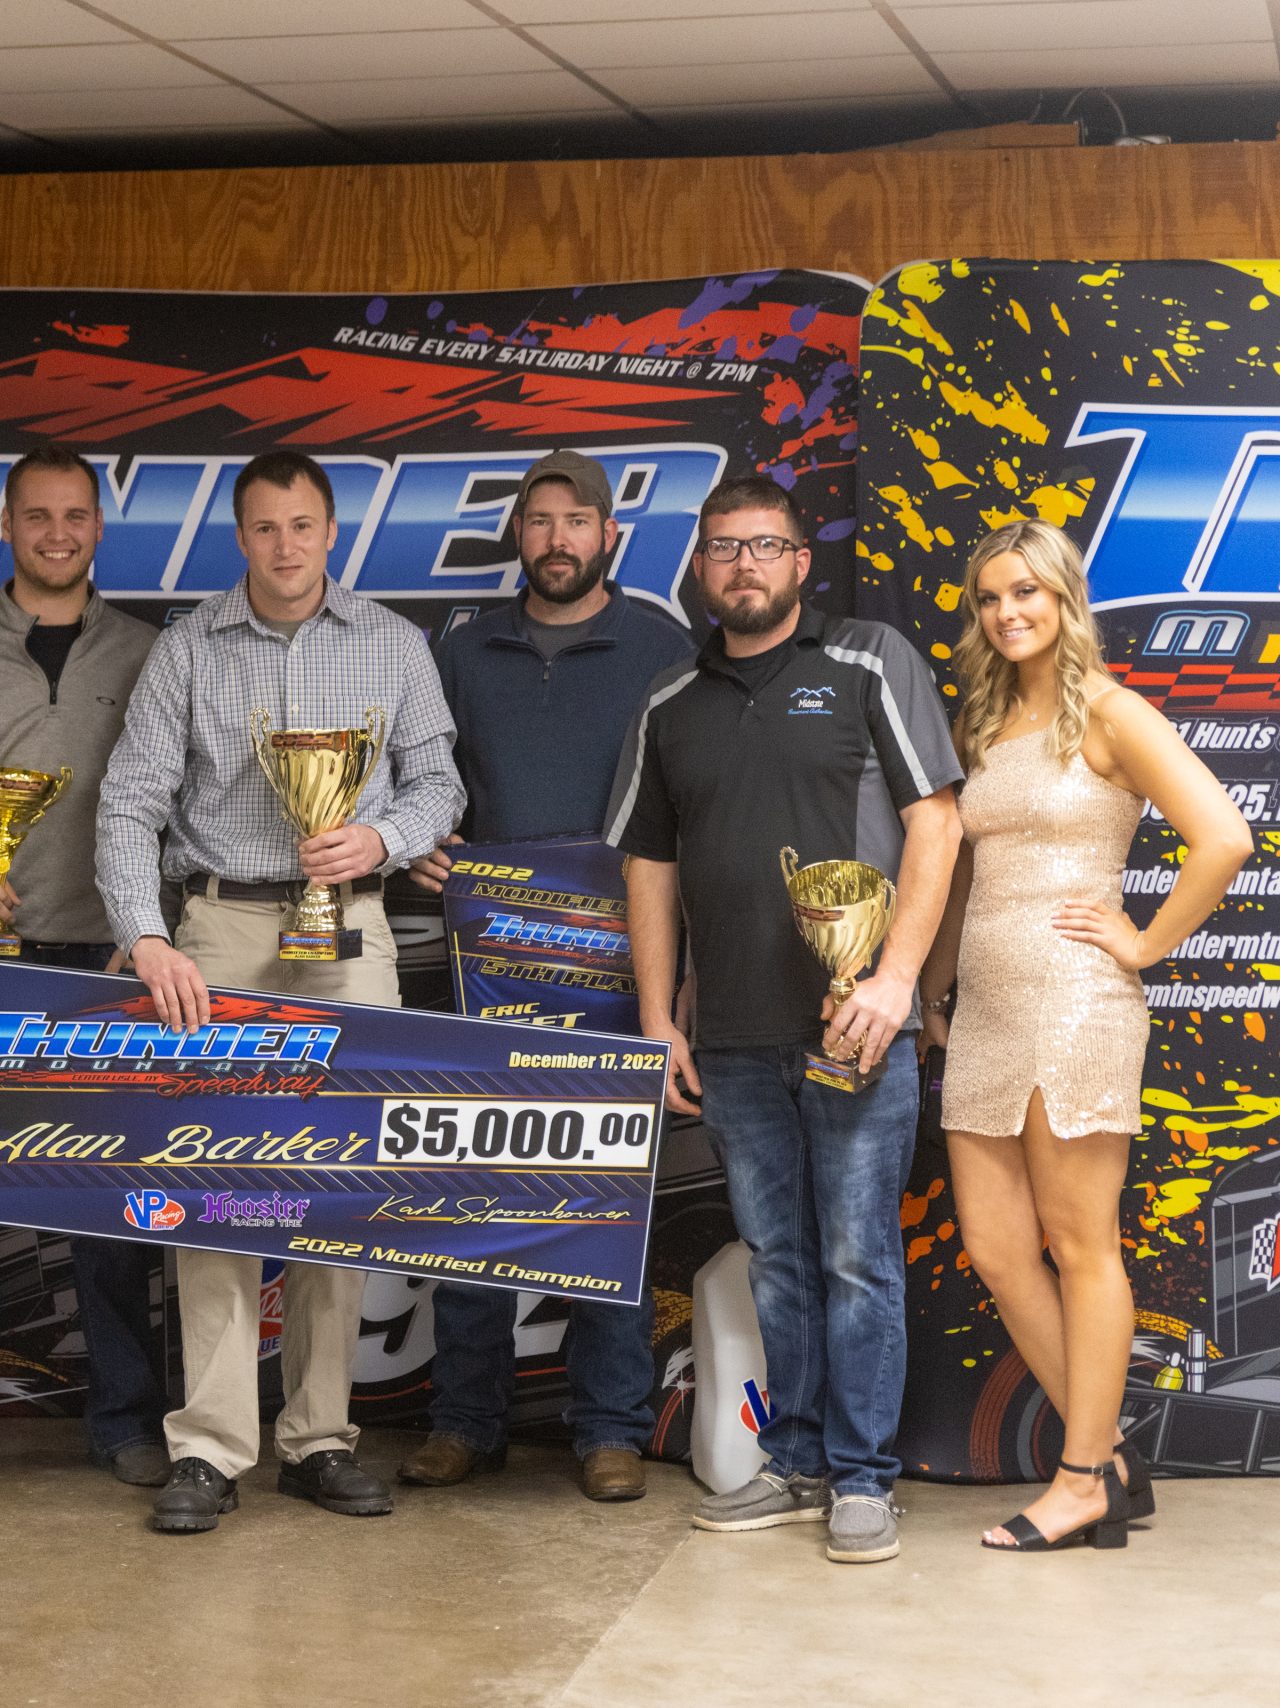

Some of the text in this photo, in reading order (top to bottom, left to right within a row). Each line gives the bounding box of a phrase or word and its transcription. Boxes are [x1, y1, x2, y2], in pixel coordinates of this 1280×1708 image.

[333, 326, 758, 382] RACING EVERY SATURDAY NIGHT @ 7PM
[1190, 722, 1276, 749] Hunts
[451, 861, 533, 881] 2022
[478, 912, 631, 953] THUND
[480, 959, 556, 981] 5TH
[559, 969, 638, 995] PLA
[480, 1002, 540, 1018] ERIC
[0, 1058, 311, 1073] MOUNTAIN
[509, 1052, 665, 1071] December 17, 2022
[156, 1072, 325, 1101] Speedway
[139, 1125, 372, 1165] Barker
[384, 1103, 649, 1162] $5,000.00
[126, 1190, 167, 1229] VP
[198, 1191, 310, 1223] Hoosier
[368, 1195, 447, 1223] Karl
[231, 1218, 302, 1228] RACING TIRE
[288, 1236, 622, 1293] 2022 Modified Champion
